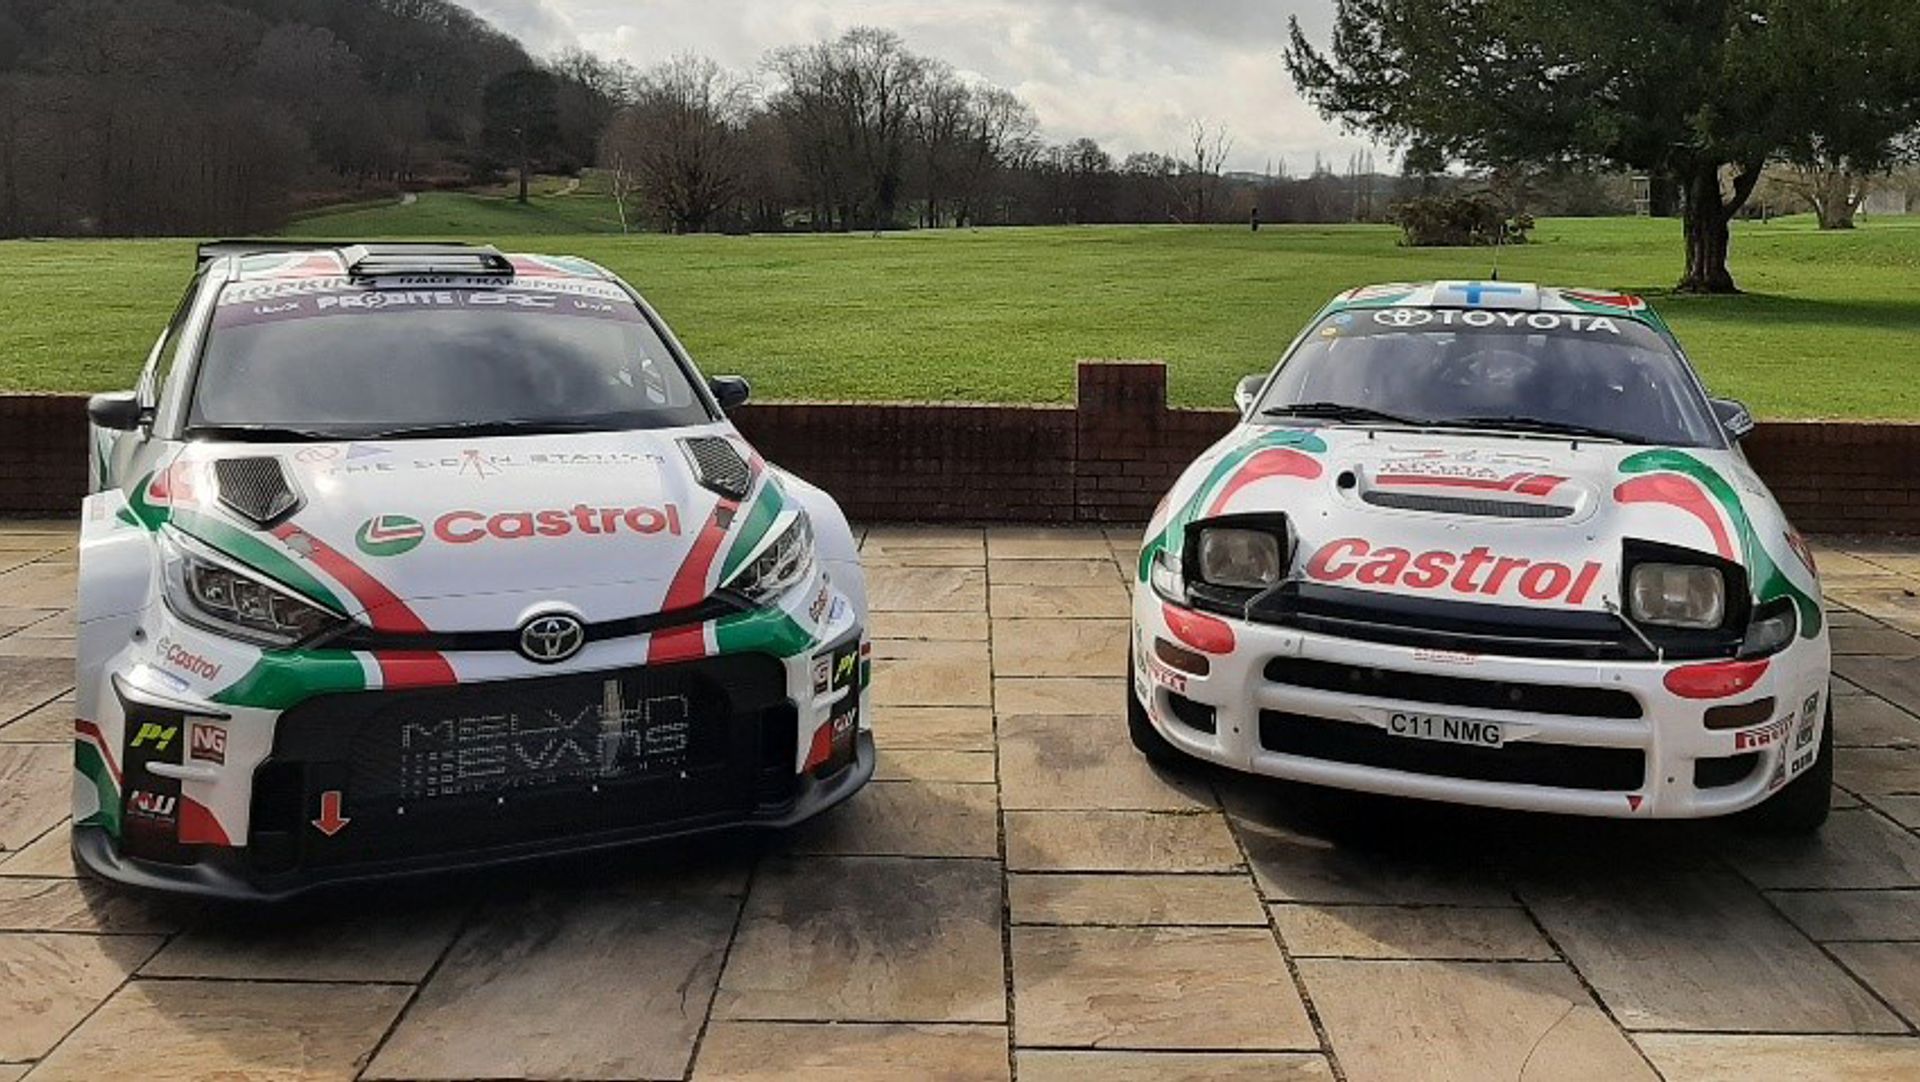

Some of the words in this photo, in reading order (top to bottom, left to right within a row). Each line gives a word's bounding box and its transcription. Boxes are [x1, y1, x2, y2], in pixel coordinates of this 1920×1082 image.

[1437, 309, 1621, 334] TOYOTA
[433, 504, 682, 544] Castrol
[1306, 537, 1602, 605] Castrol
[167, 643, 223, 681] Castrol
[192, 724, 227, 754] NG
[1391, 713, 1432, 736] C11
[1443, 718, 1500, 745] NMG
